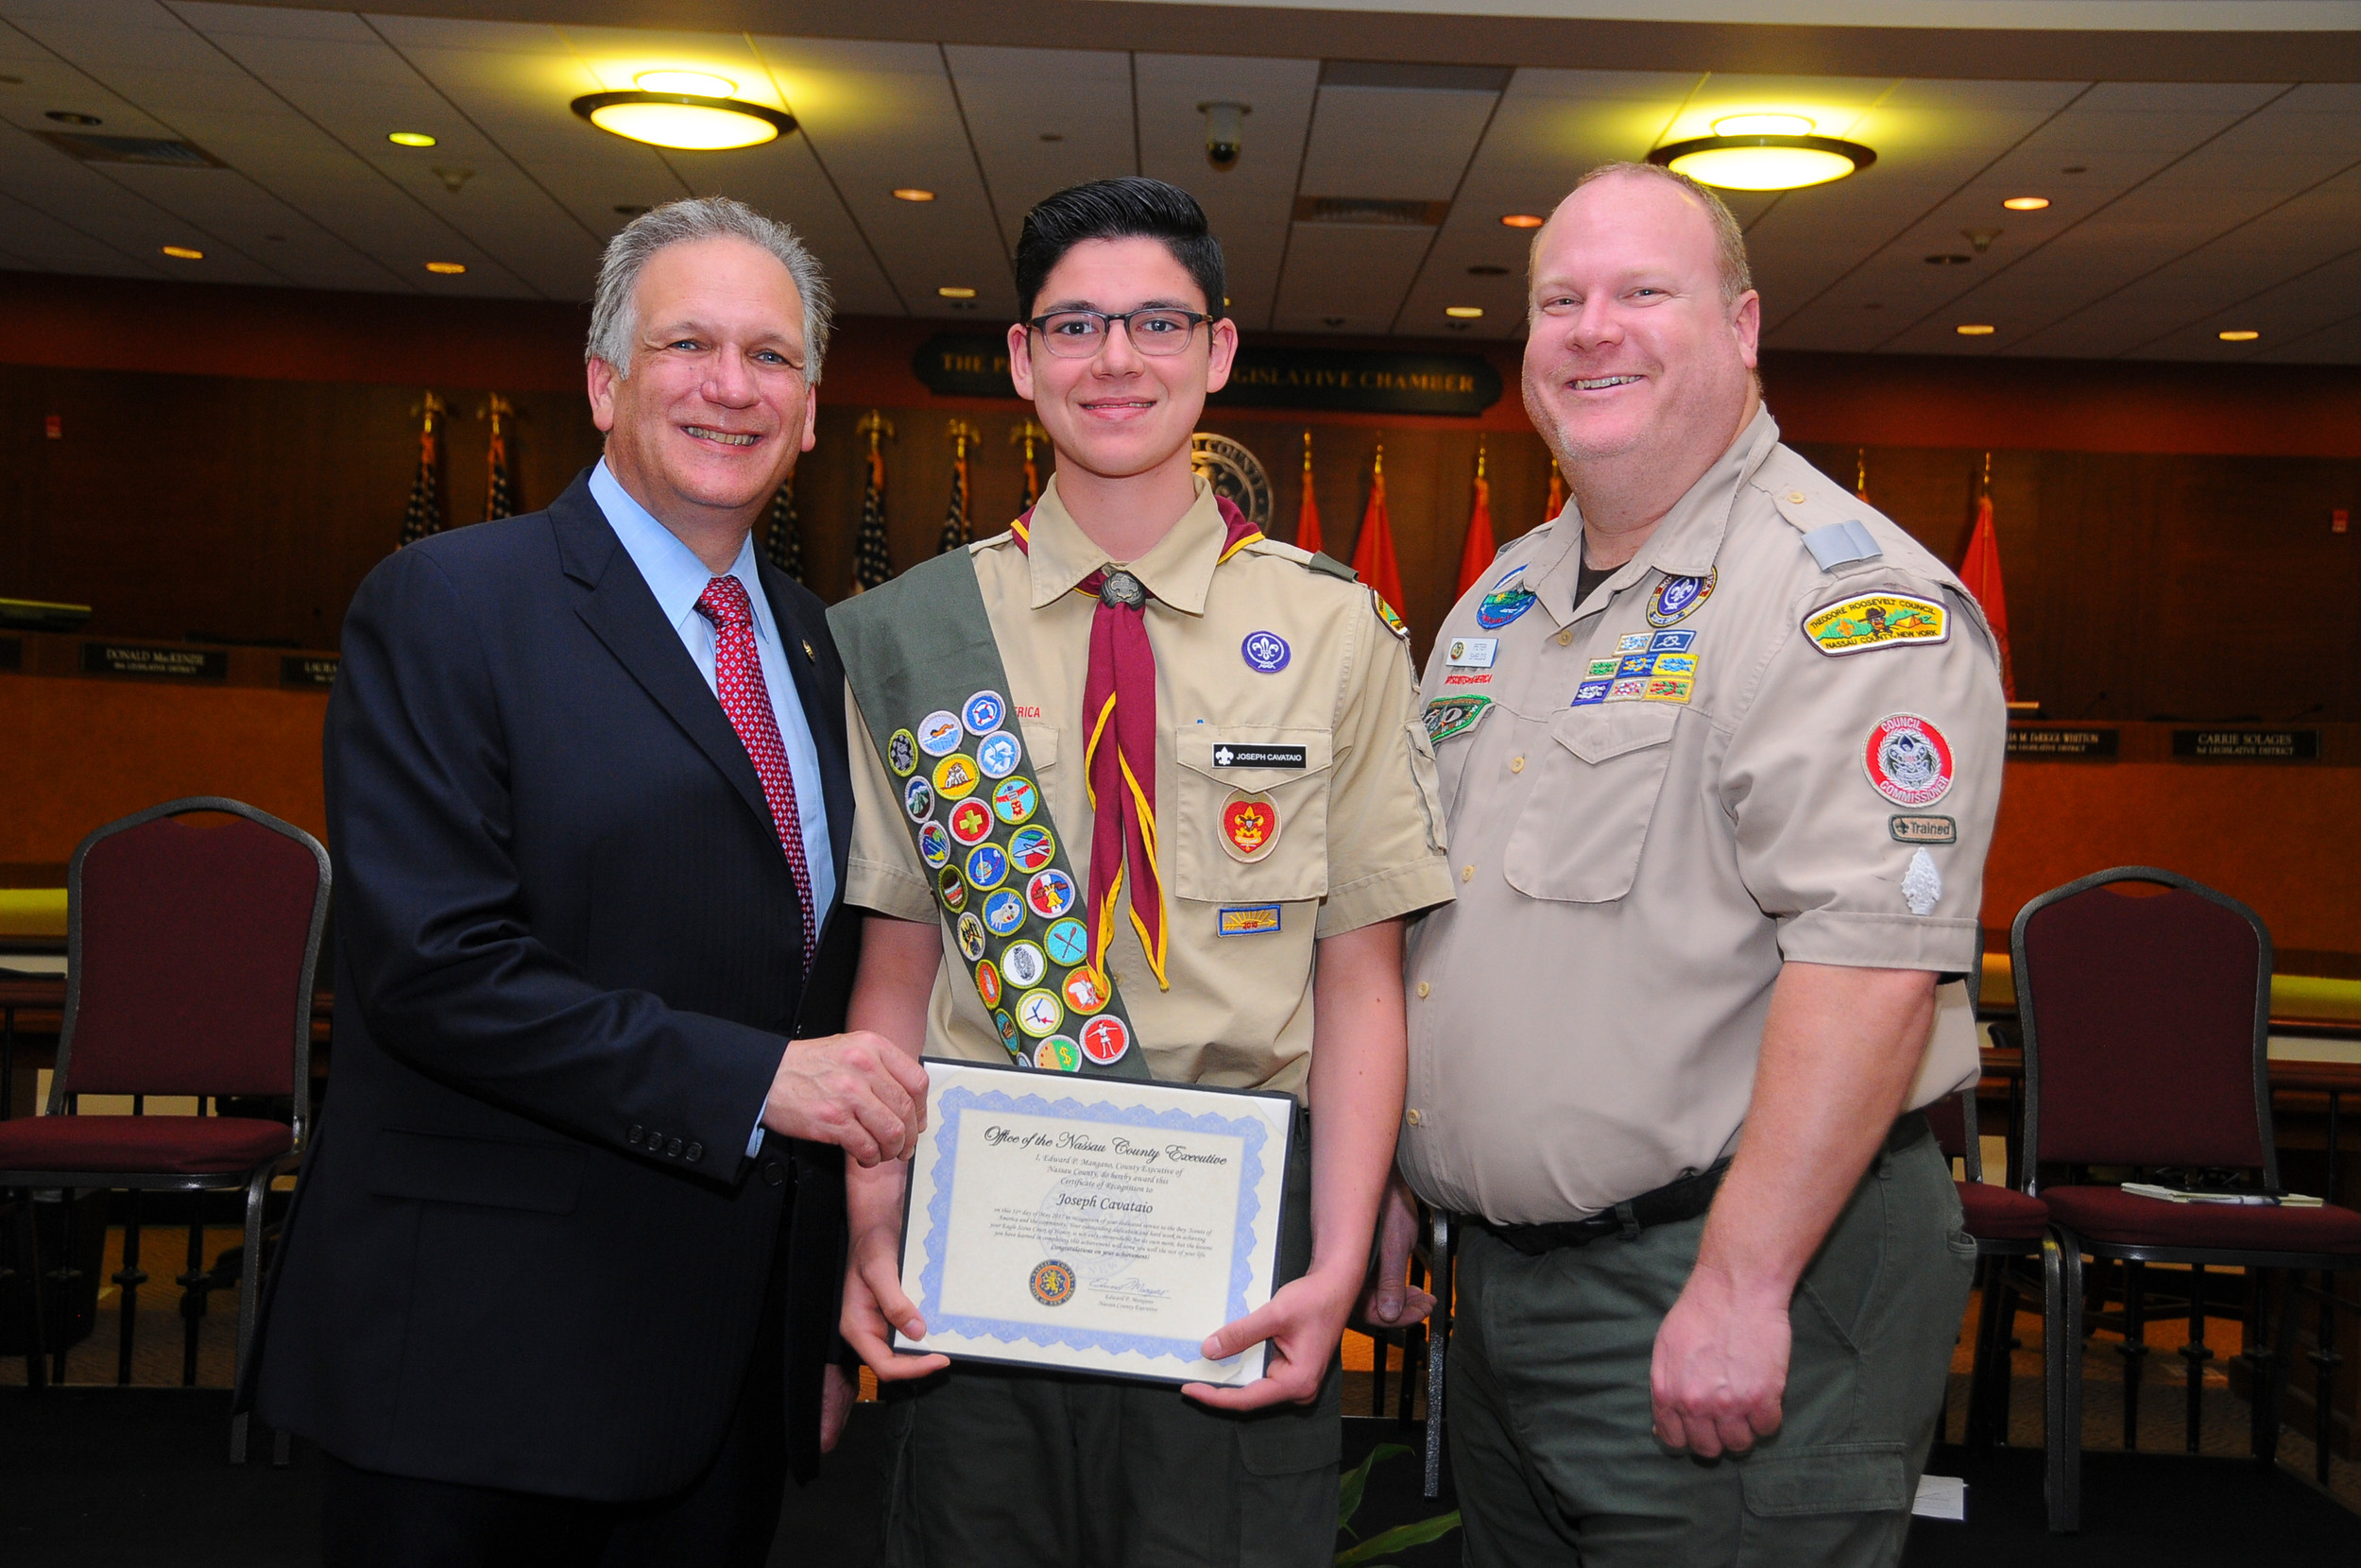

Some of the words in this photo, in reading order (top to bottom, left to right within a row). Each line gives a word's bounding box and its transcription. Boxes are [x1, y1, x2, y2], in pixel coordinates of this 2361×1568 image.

[941, 353, 984, 373] THE
[1360, 370, 1476, 393] CHAMBER
[1809, 606, 1848, 629] THEODORE
[1849, 598, 1897, 610] ROOSEVELT
[1899, 600, 1936, 615] COUNCIL
[1825, 639, 1858, 649] NASSAU
[1897, 630, 1914, 639] NEW
[1917, 629, 1938, 638] YORK
[106, 648, 150, 660] DONALD
[1880, 717, 1923, 733] COUNCIL
[2198, 733, 2239, 745] CARRIE
[2243, 734, 2292, 745] SOLAGES
[1236, 753, 1266, 761] JOSEPH
[1267, 753, 1302, 762] CAVATAIO
[2258, 746, 2294, 755] DISTRICT
[1879, 775, 1951, 803] COMMISSIONER
[1910, 821, 1950, 835] Trained
[984, 1125, 1019, 1147] Office
[1019, 1133, 1038, 1150] of
[1035, 1133, 1052, 1147] the
[1055, 1132, 1106, 1151] Nassau
[1111, 1136, 1160, 1165] County
[1165, 1144, 1227, 1166] Executive
[1060, 1177, 1095, 1188] Certificate
[1095, 1179, 1105, 1189] of
[1056, 1193, 1098, 1210] Joseph
[1100, 1197, 1154, 1214] Cavataio
